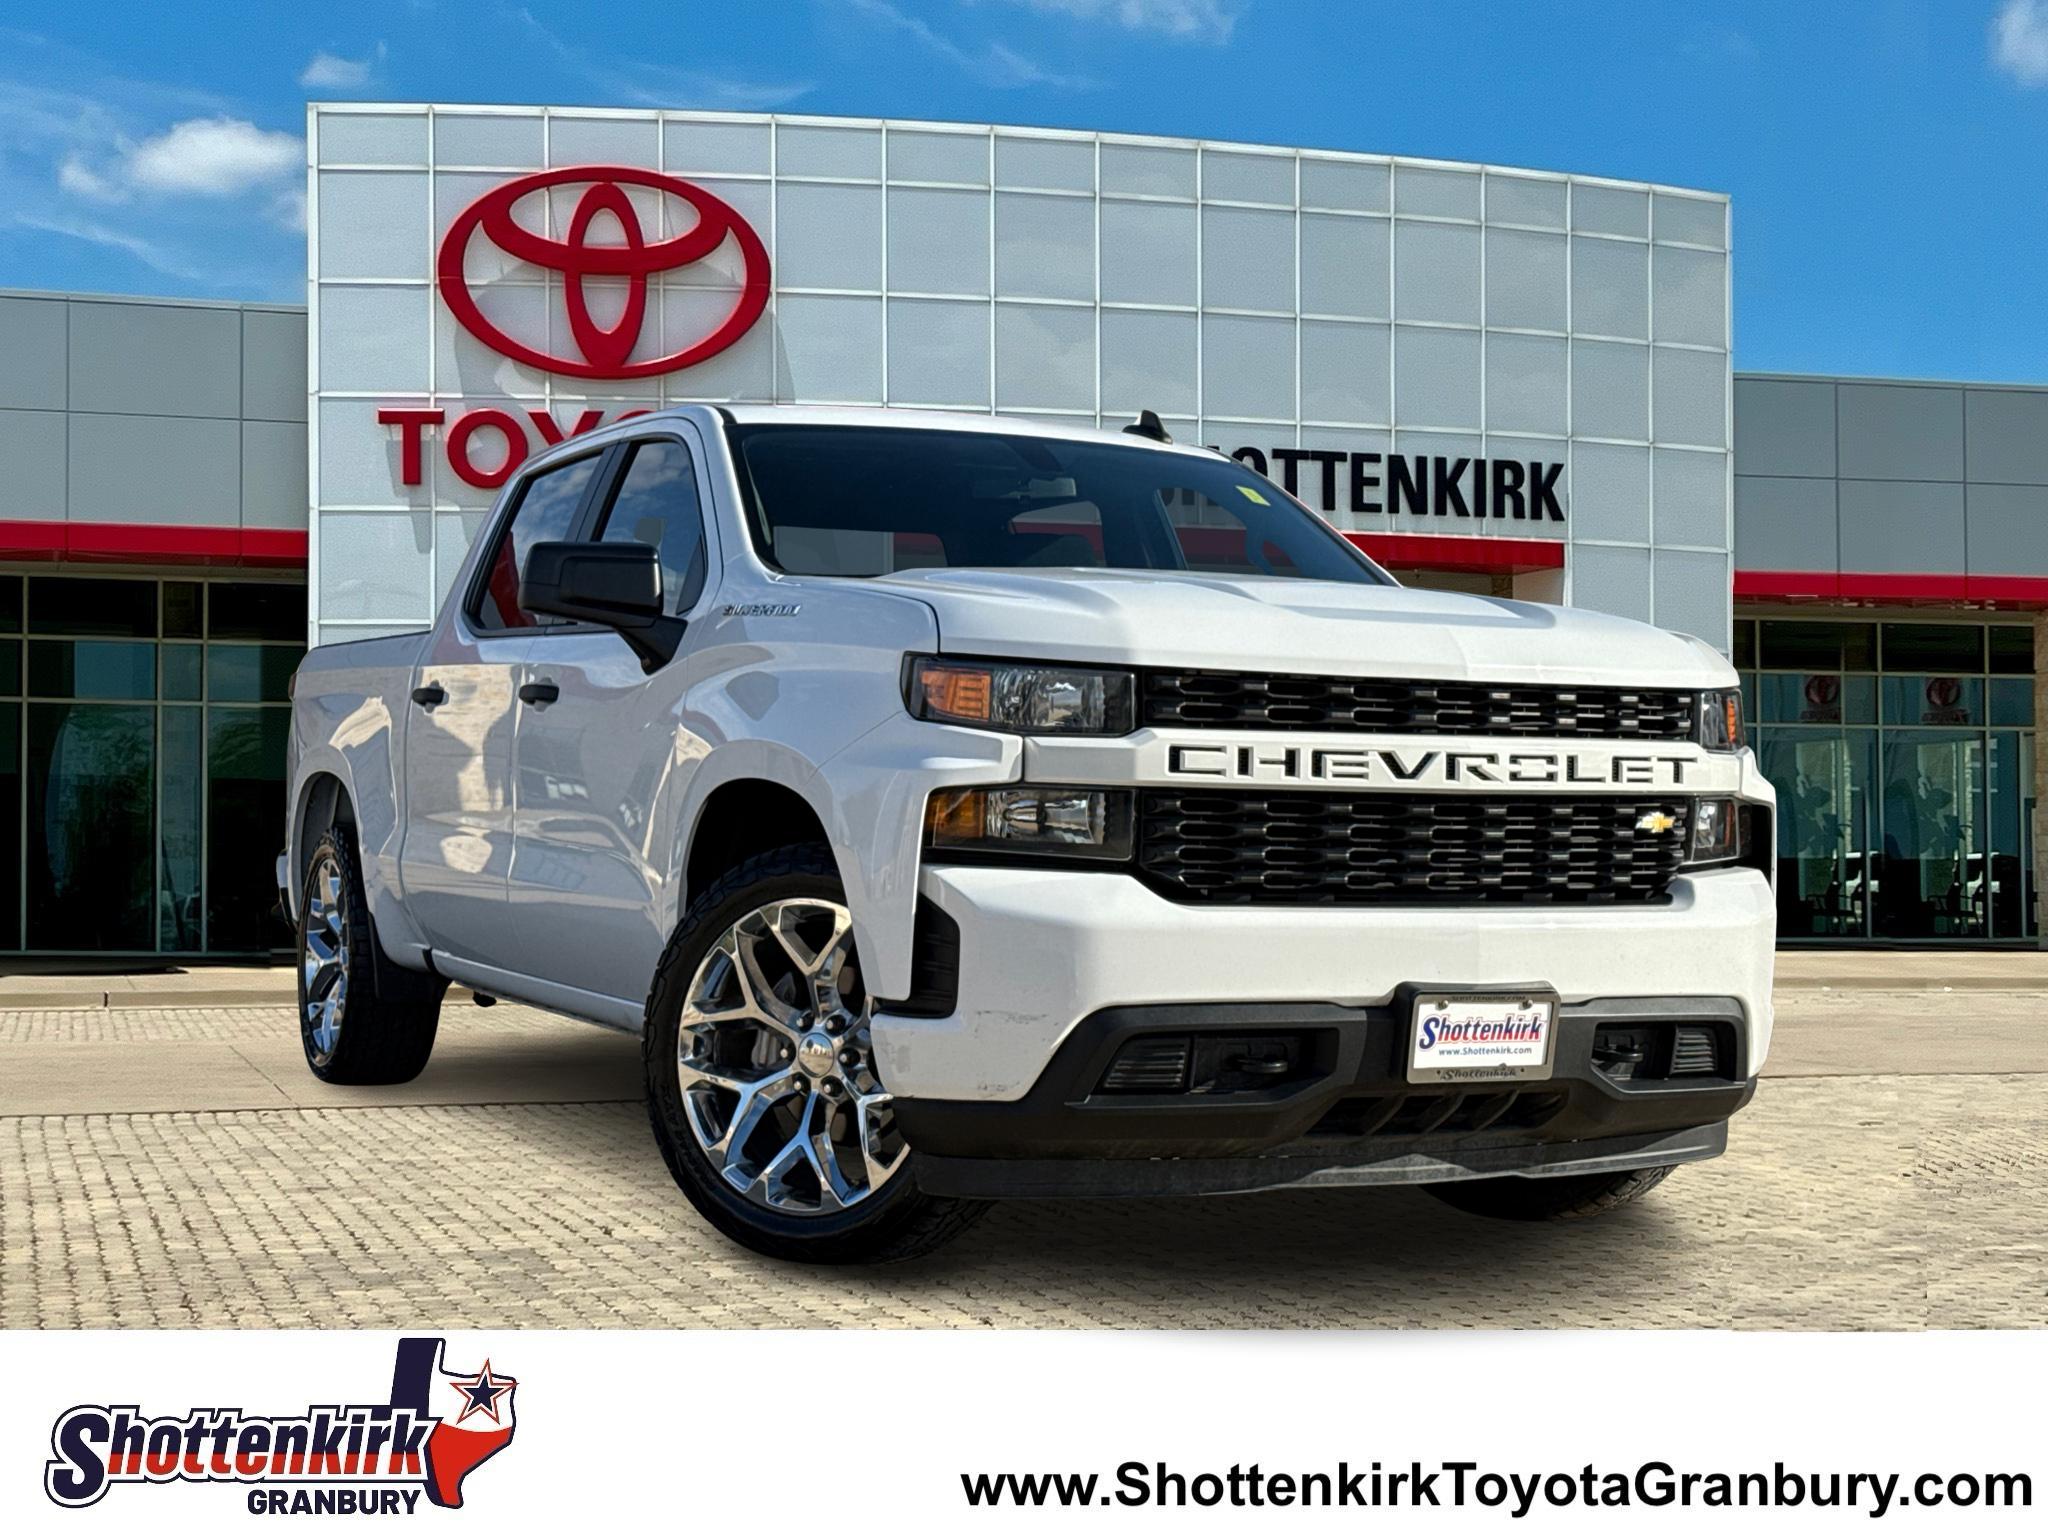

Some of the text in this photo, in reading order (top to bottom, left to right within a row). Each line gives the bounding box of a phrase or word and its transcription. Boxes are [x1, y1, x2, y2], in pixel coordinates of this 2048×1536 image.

[378, 407, 658, 489] TOY
[1168, 744, 1698, 784] CHEVROLET
[1419, 1015, 1543, 1050] Shottenkirk
[1438, 1046, 1532, 1056] www.Shottenkirk.com
